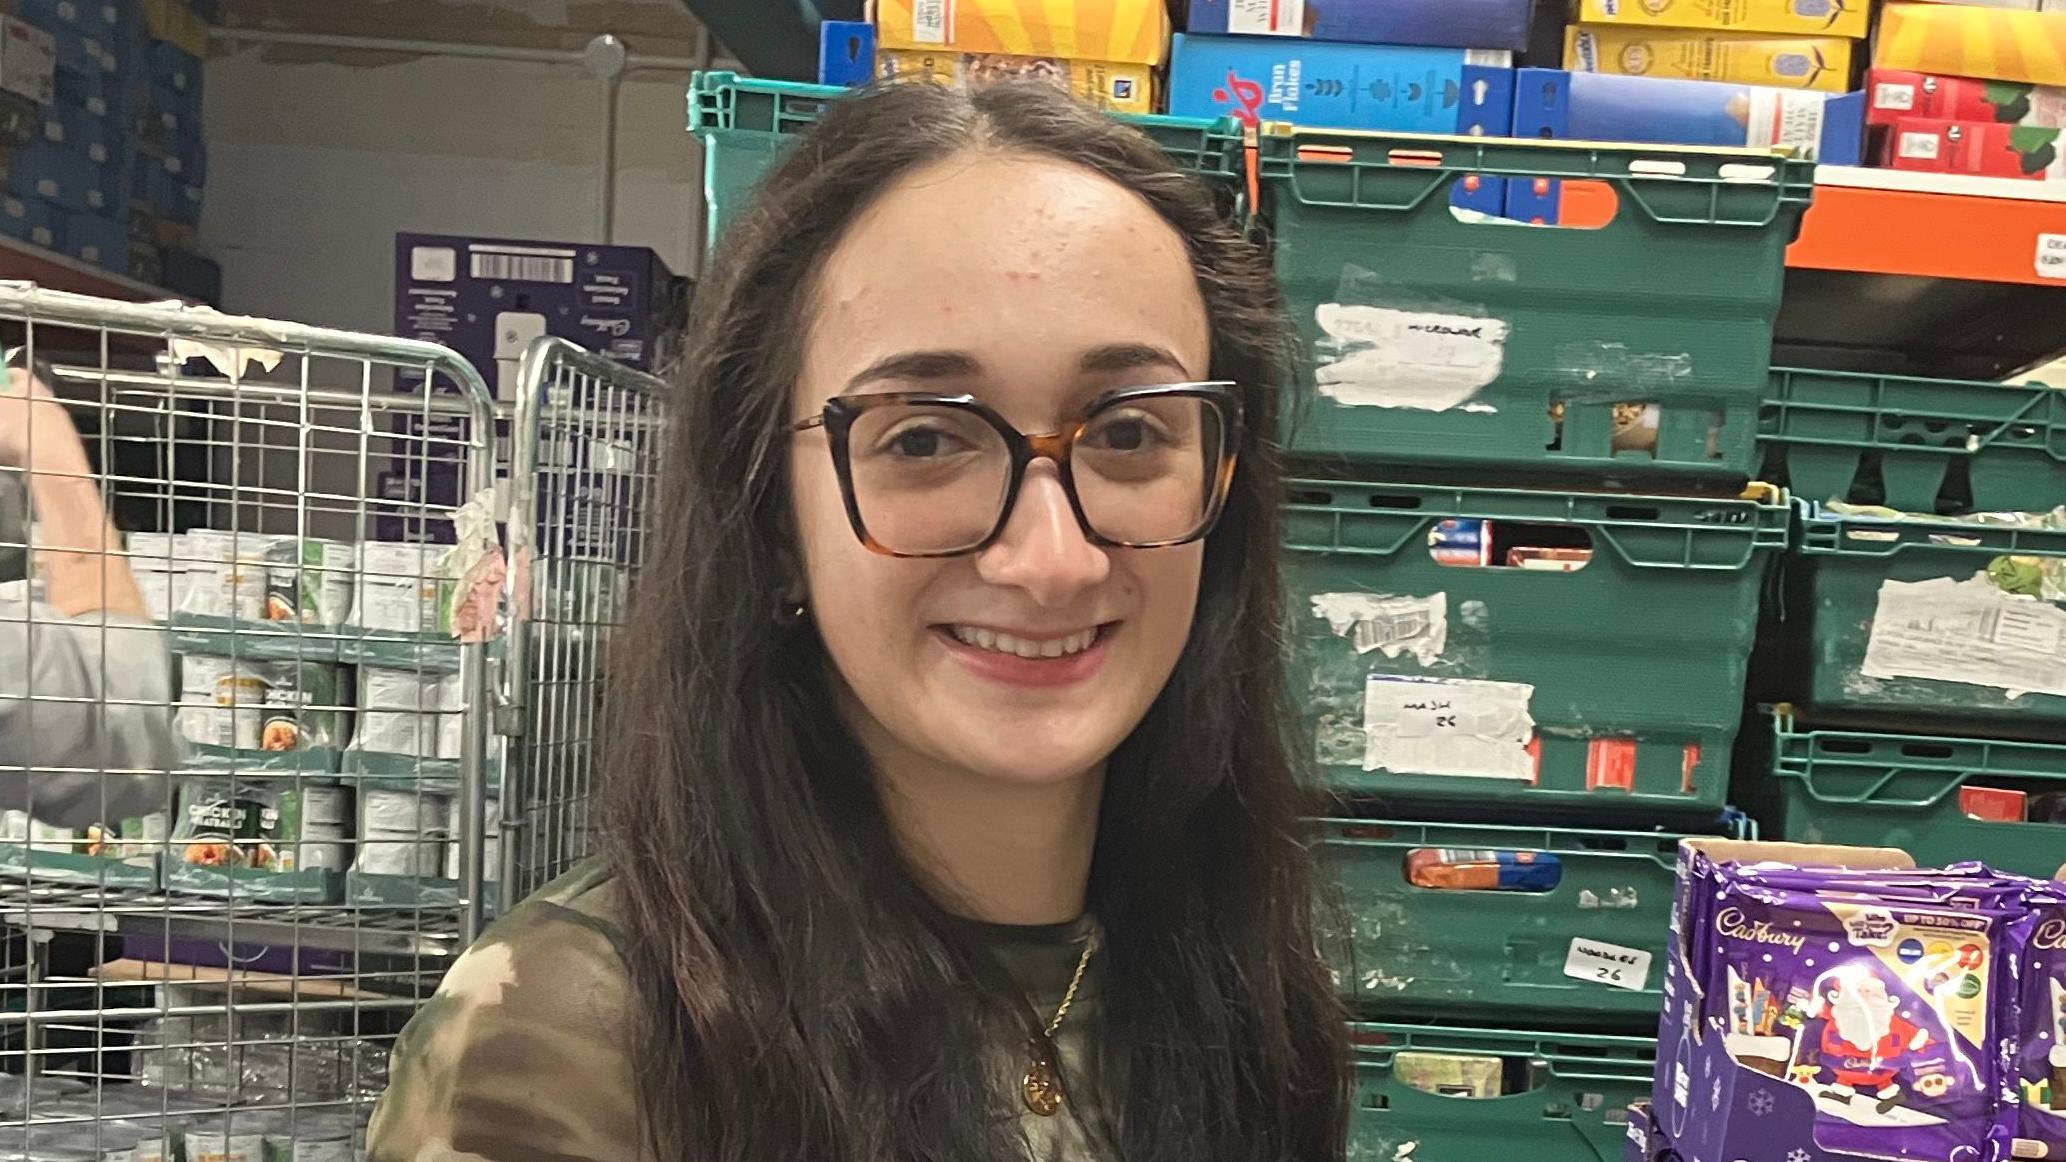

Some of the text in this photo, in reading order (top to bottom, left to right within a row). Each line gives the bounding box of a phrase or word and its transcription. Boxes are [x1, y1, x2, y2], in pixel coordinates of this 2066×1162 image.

[1268, 64, 1287, 103] Bran
[1282, 59, 1301, 112] Flakes
[1715, 906, 1806, 955] Cadbury
[1596, 967, 1622, 981] 26
